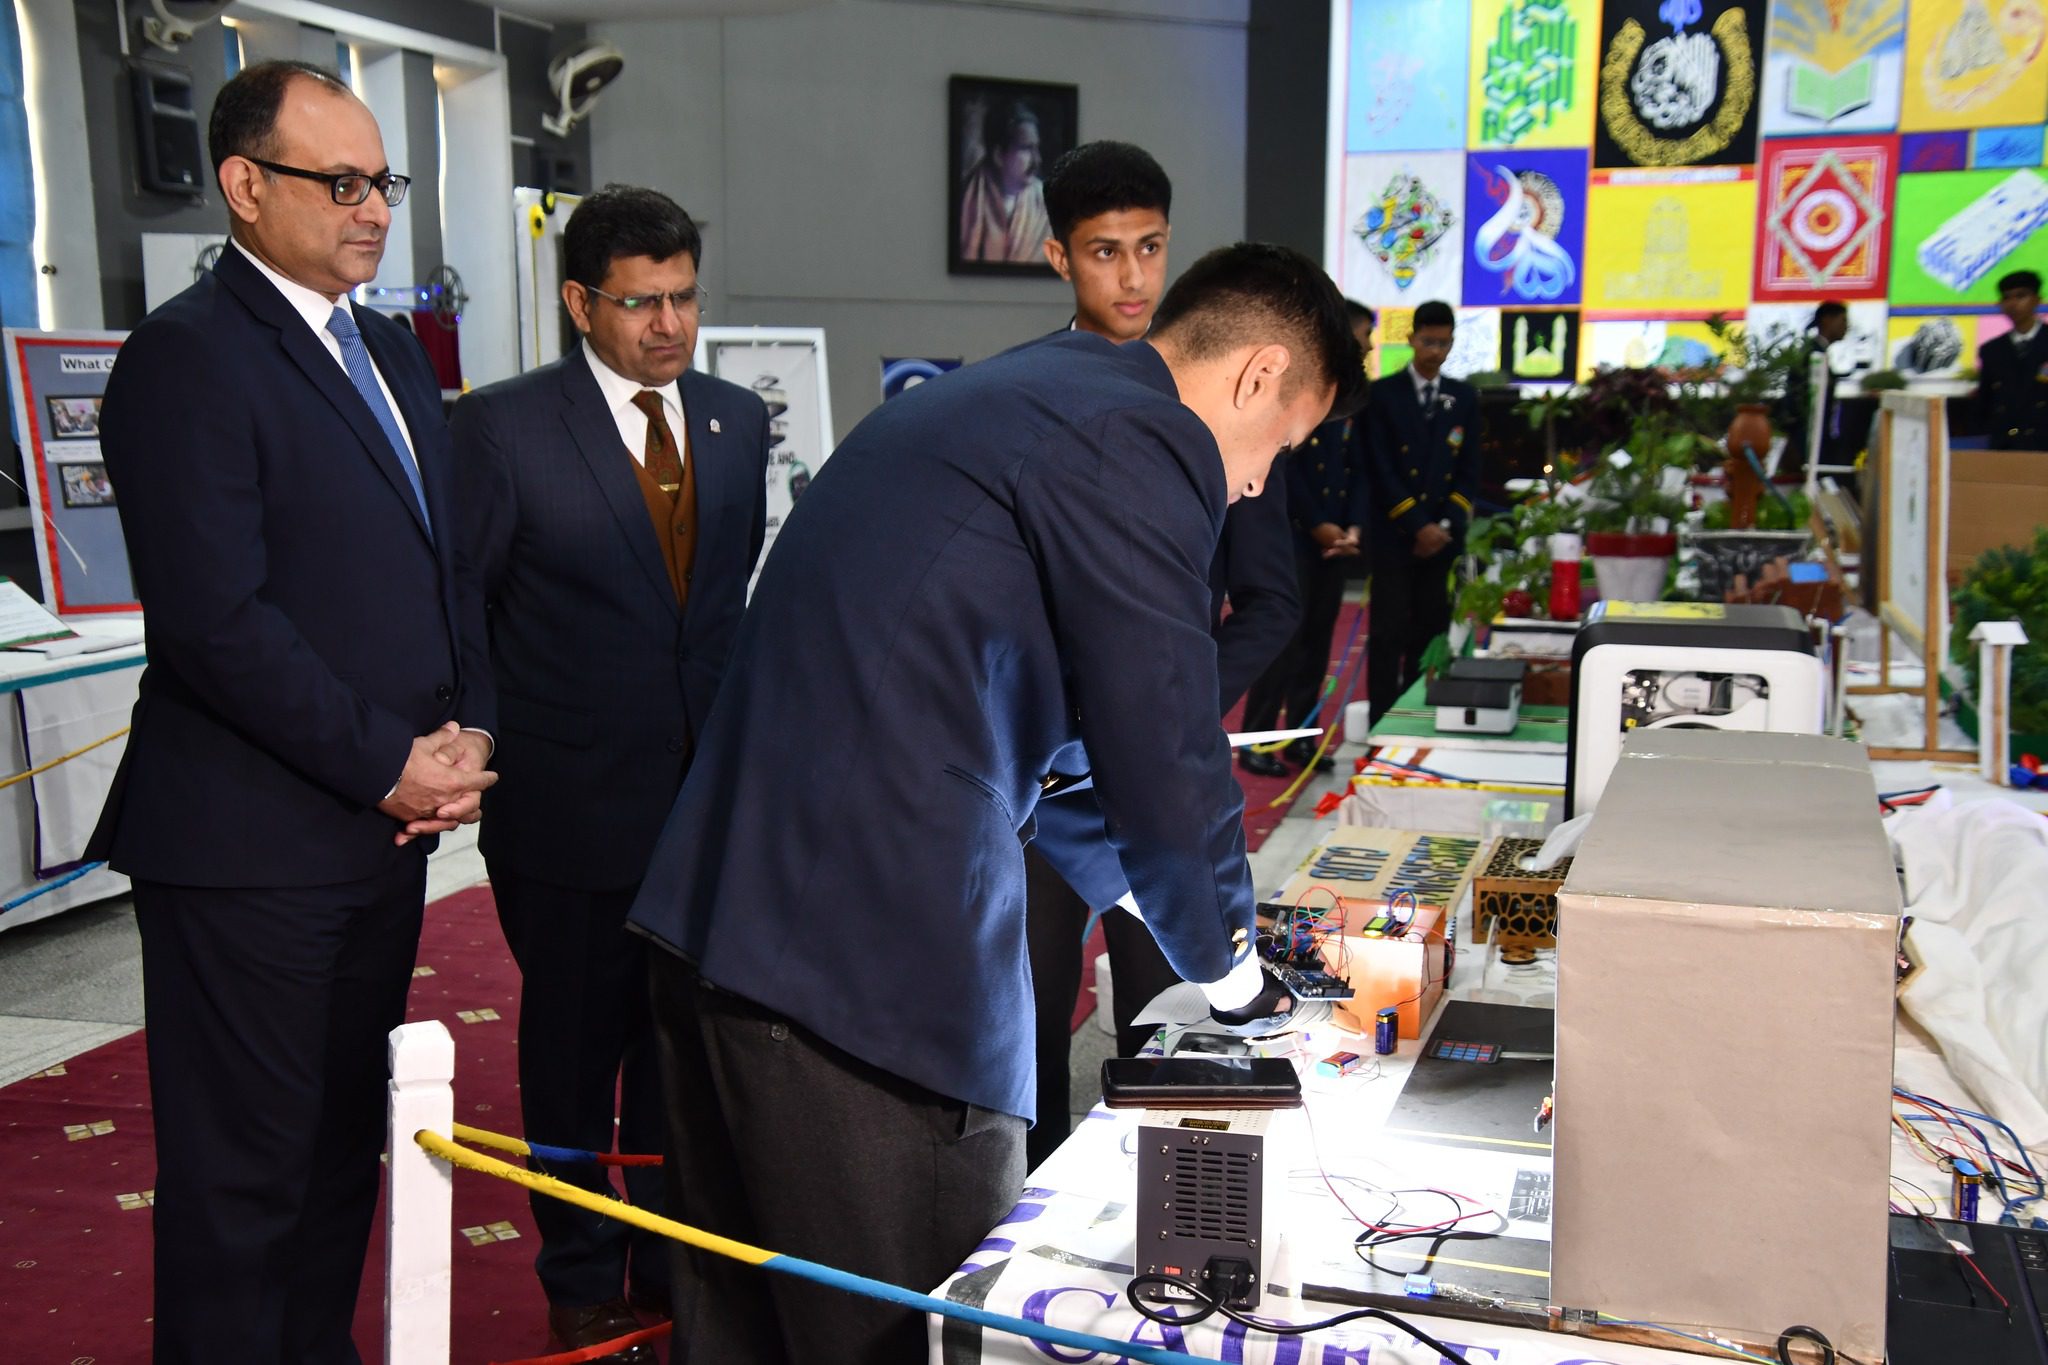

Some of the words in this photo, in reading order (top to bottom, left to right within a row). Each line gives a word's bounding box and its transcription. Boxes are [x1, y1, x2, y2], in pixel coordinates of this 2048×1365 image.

[62, 357, 100, 370] What
[1310, 845, 1390, 882] CLUB
[1382, 836, 1480, 903] MAKERSPAC
